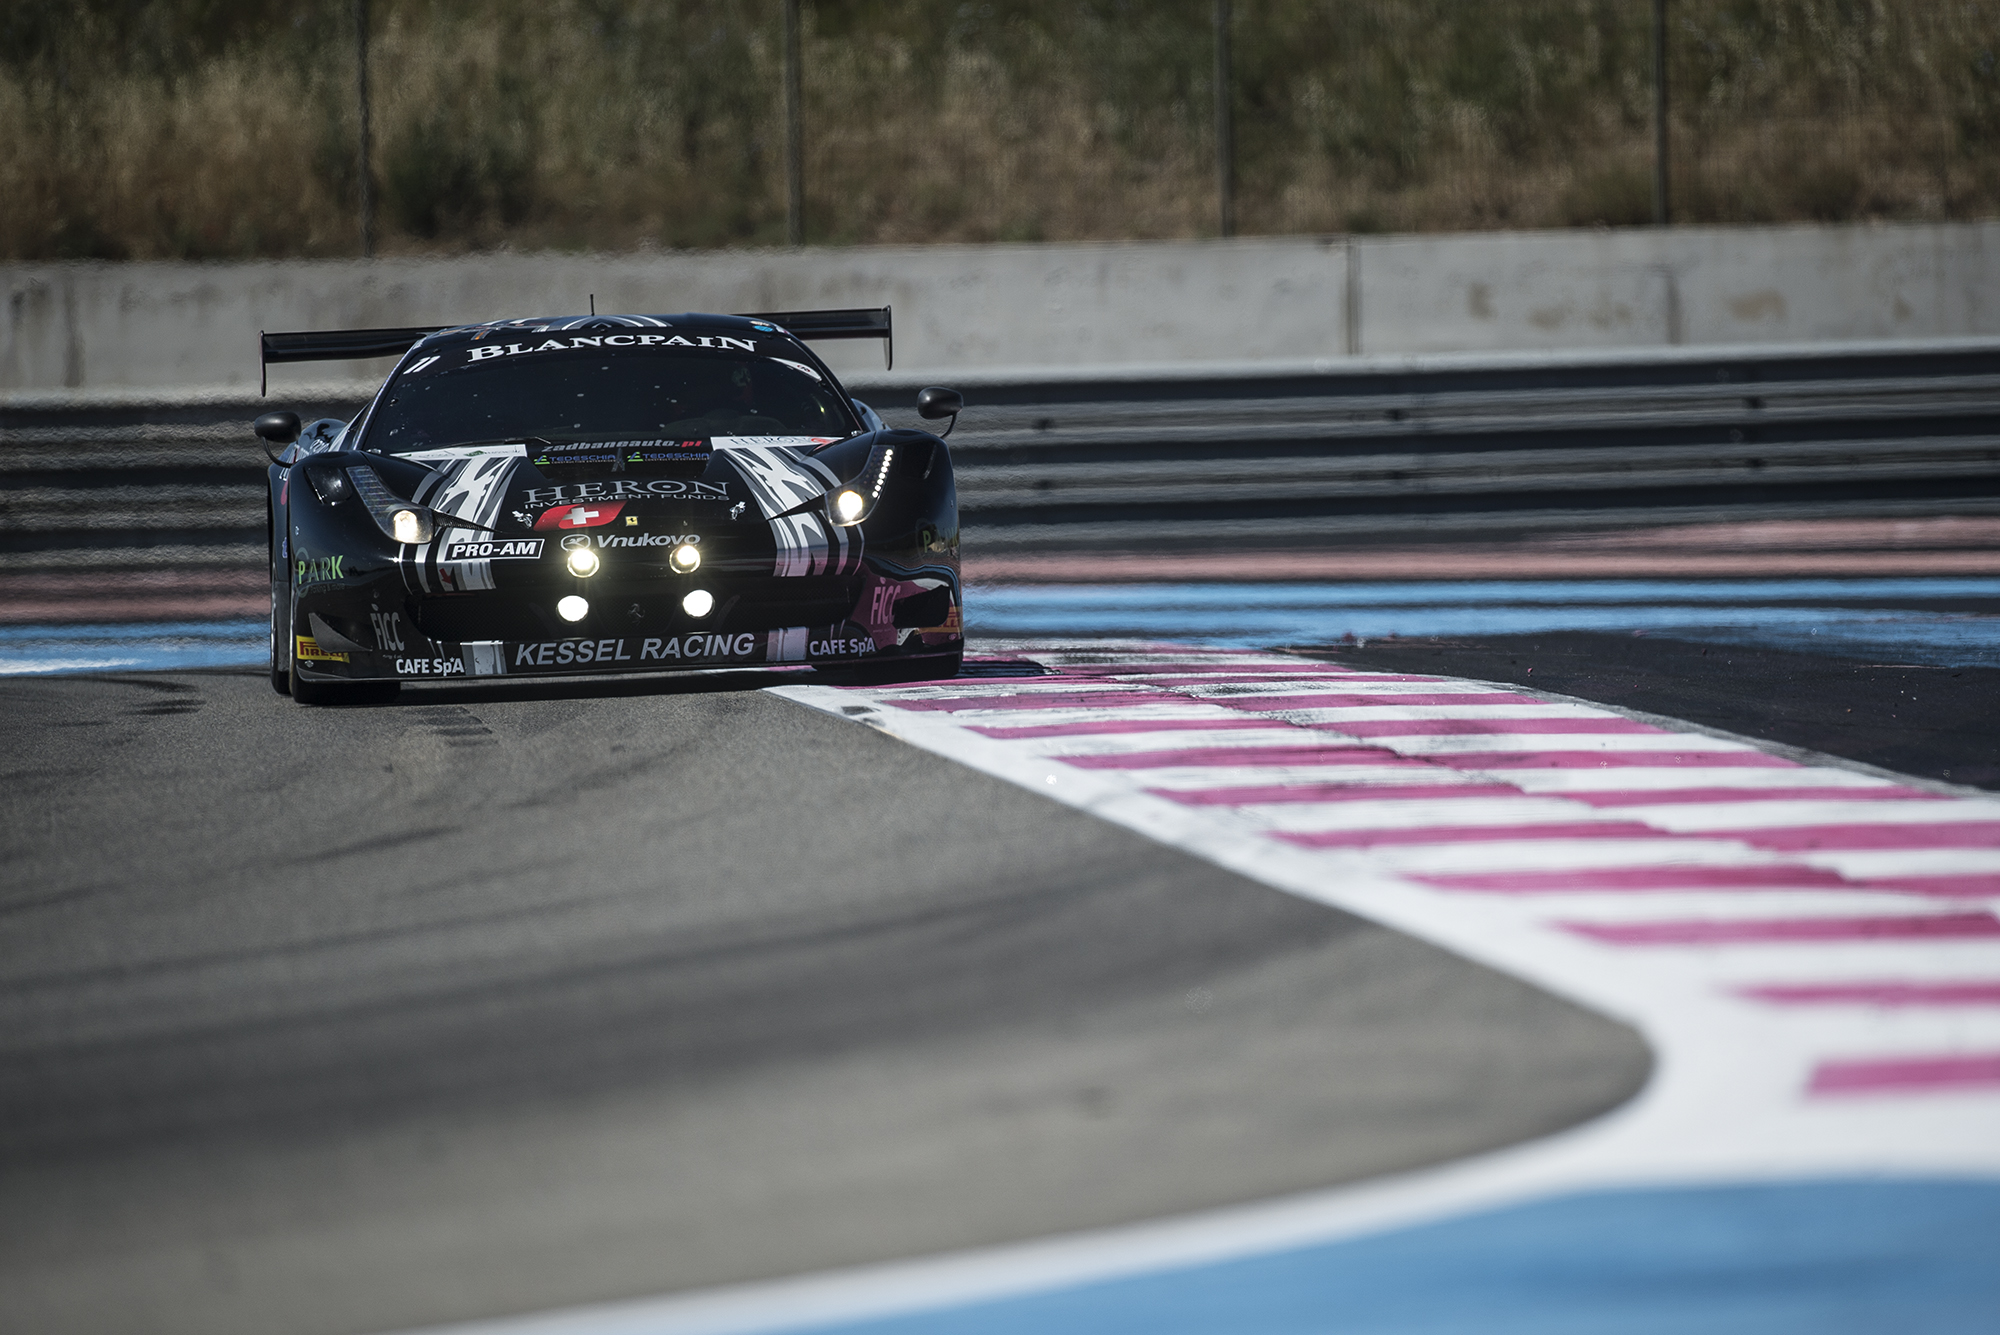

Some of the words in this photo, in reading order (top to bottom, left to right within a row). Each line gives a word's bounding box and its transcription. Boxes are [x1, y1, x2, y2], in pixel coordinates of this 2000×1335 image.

[466, 334, 757, 363] BLANCPAIN
[541, 439, 702, 453] zadbaneauto.pl
[522, 480, 730, 503] HERON
[524, 493, 655, 509] INVESTMENT
[596, 533, 701, 548] Vnukovo
[452, 541, 537, 558] PRO-AM
[298, 555, 344, 585] PARK
[515, 639, 631, 666] KESSEL
[640, 633, 755, 660] RACING
[809, 639, 846, 656] CAFE
[396, 658, 430, 674] CAFE
